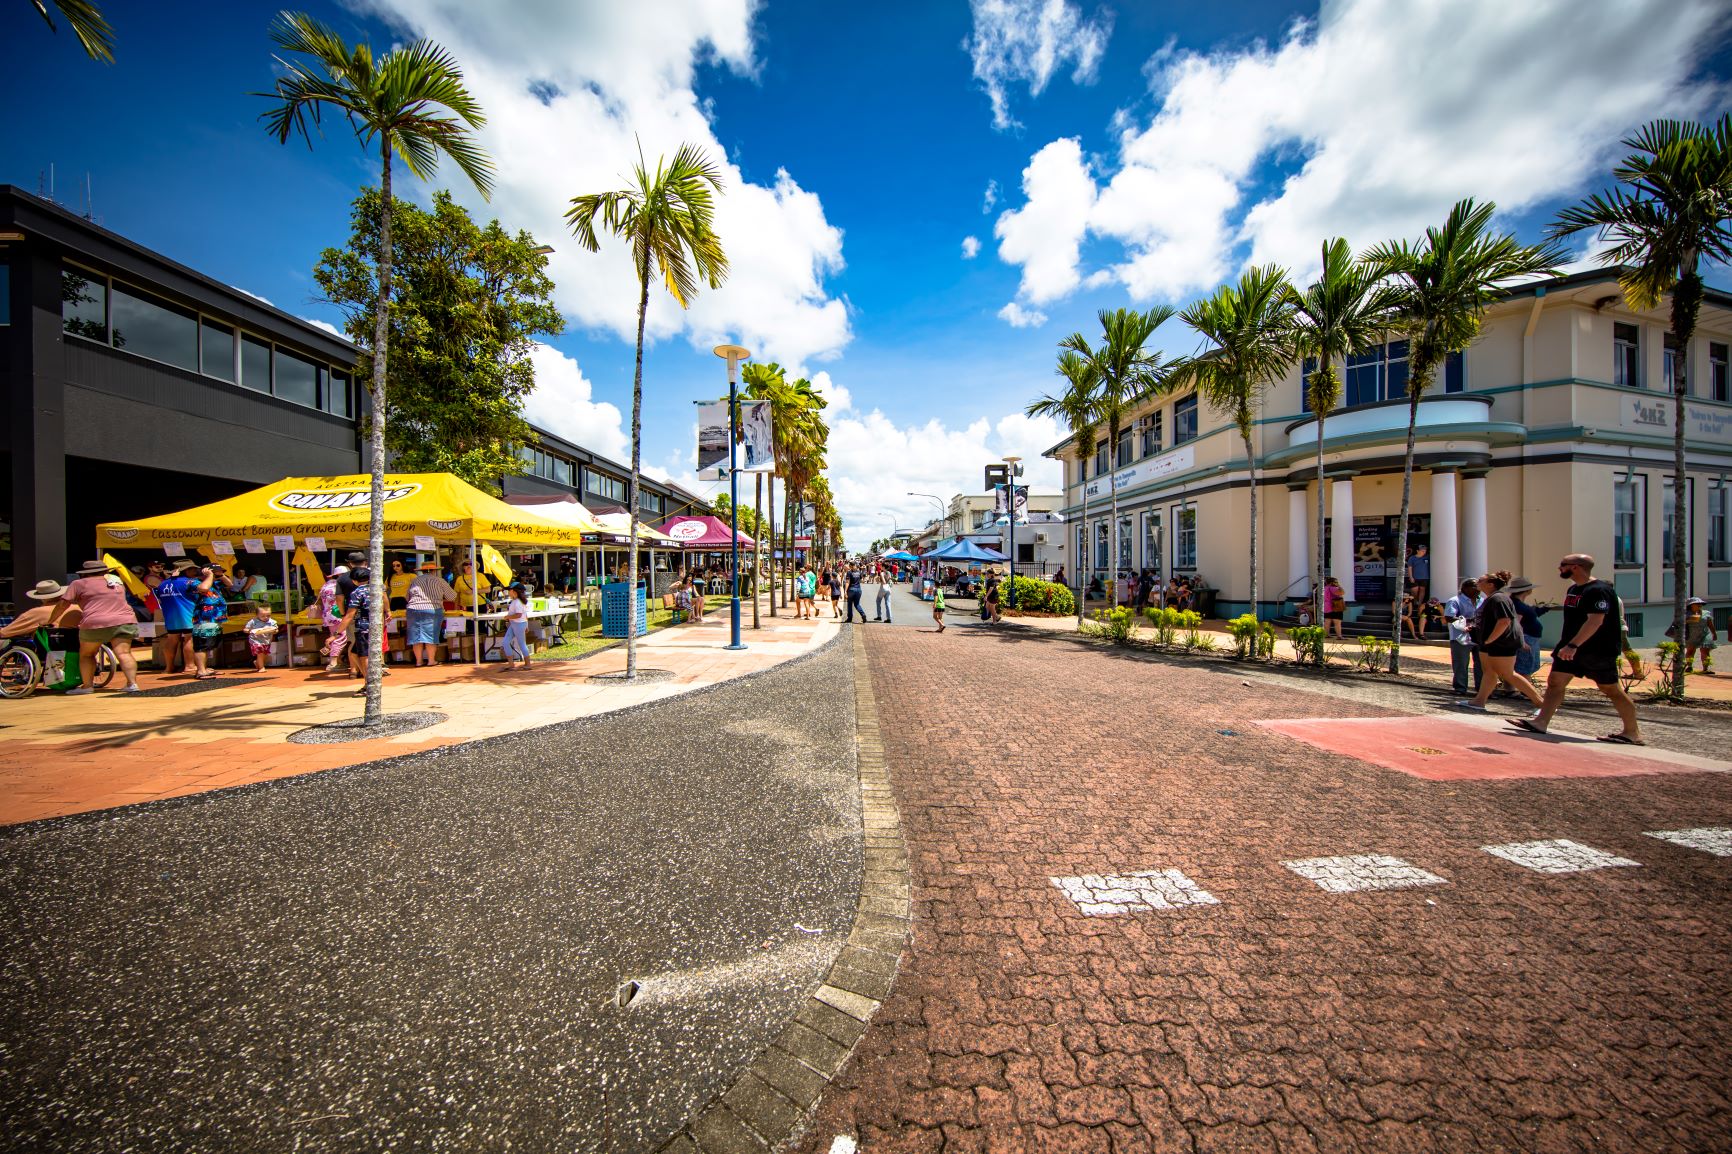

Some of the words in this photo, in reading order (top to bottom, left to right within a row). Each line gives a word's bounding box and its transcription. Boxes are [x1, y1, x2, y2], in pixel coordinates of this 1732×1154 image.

[316, 480, 402, 489] AUSTRAAN
[151, 528, 211, 540] Cassowary
[215, 526, 247, 537] Coast
[251, 525, 292, 535] Banana
[295, 522, 346, 534] Growers
[350, 520, 416, 533] Assiation
[428, 519, 462, 531] BANANAS
[492, 522, 512, 533] MAKE
[514, 524, 533, 535] YOUR
